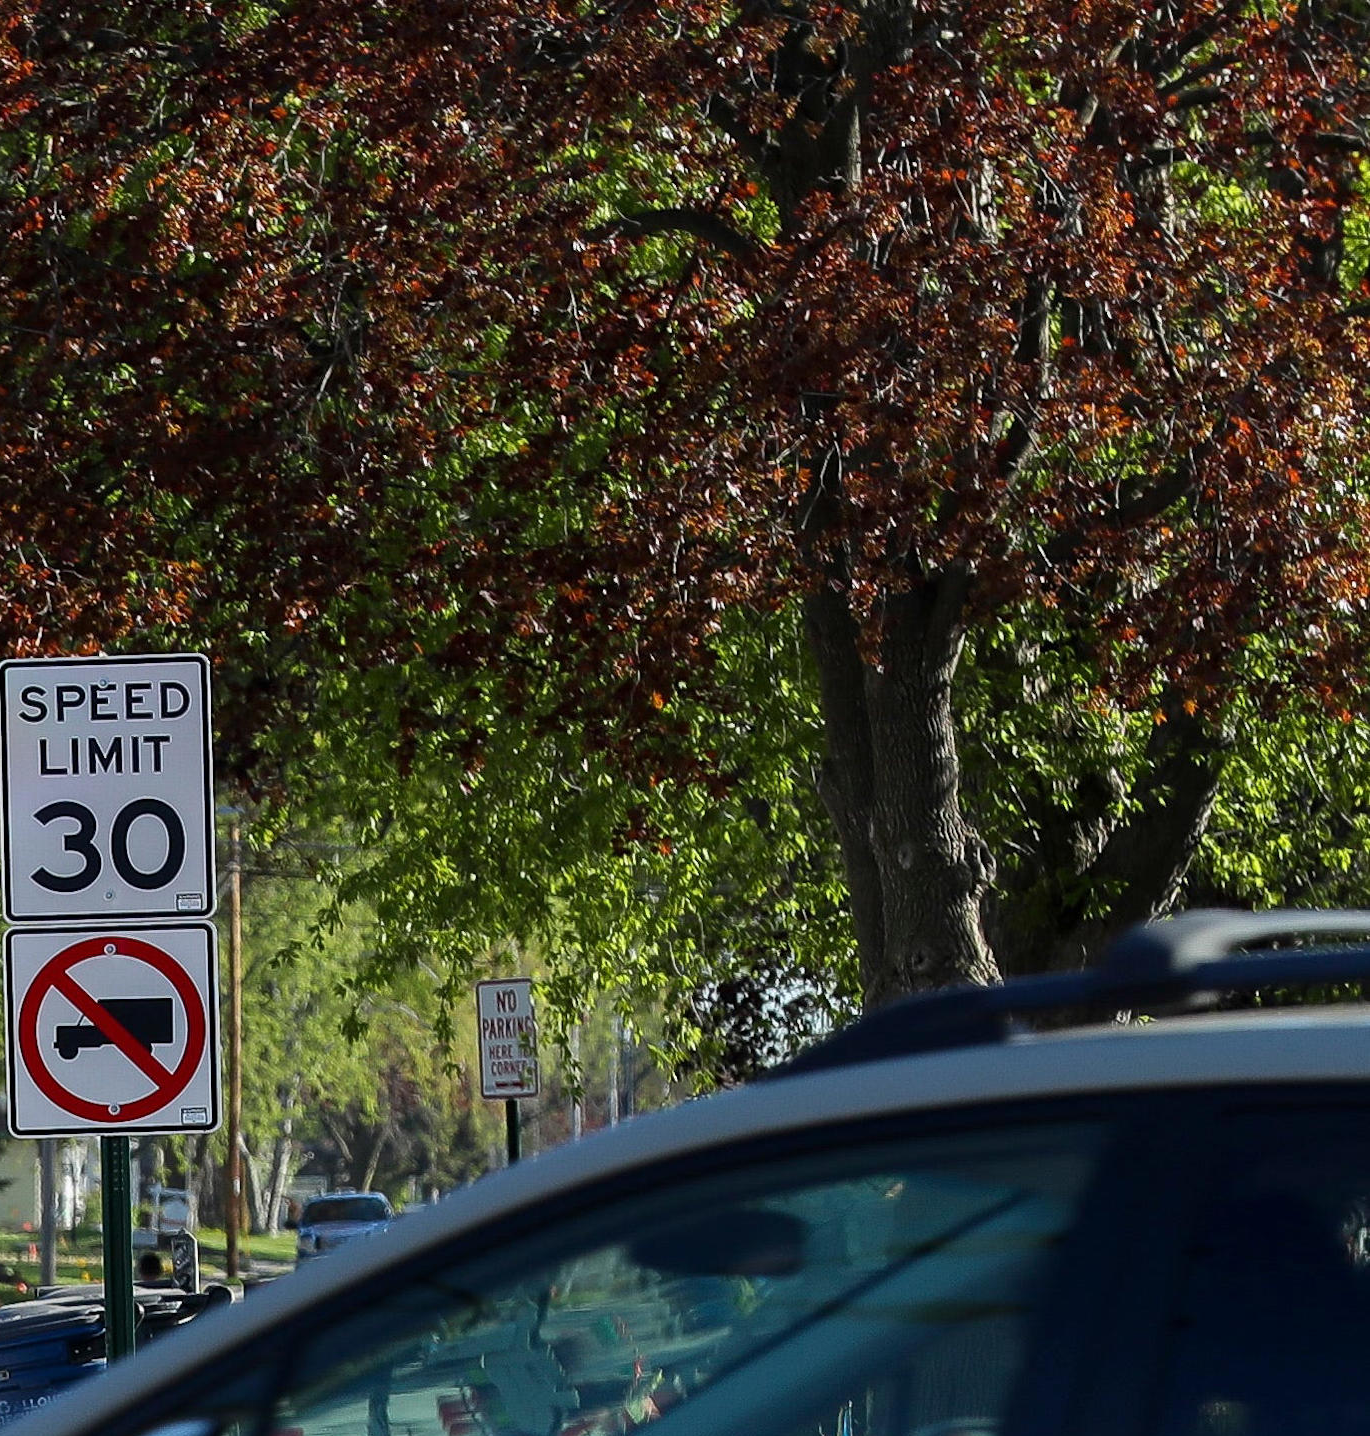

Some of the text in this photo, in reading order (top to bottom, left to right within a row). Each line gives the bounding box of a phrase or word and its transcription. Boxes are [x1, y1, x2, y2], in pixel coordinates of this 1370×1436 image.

[18, 681, 191, 723] SPEED
[39, 735, 171, 776] LIMIT
[30, 797, 186, 893] 30
[495, 989, 517, 1013] NO
[482, 1015, 534, 1040] PARKING
[488, 1044, 513, 1060] HERE
